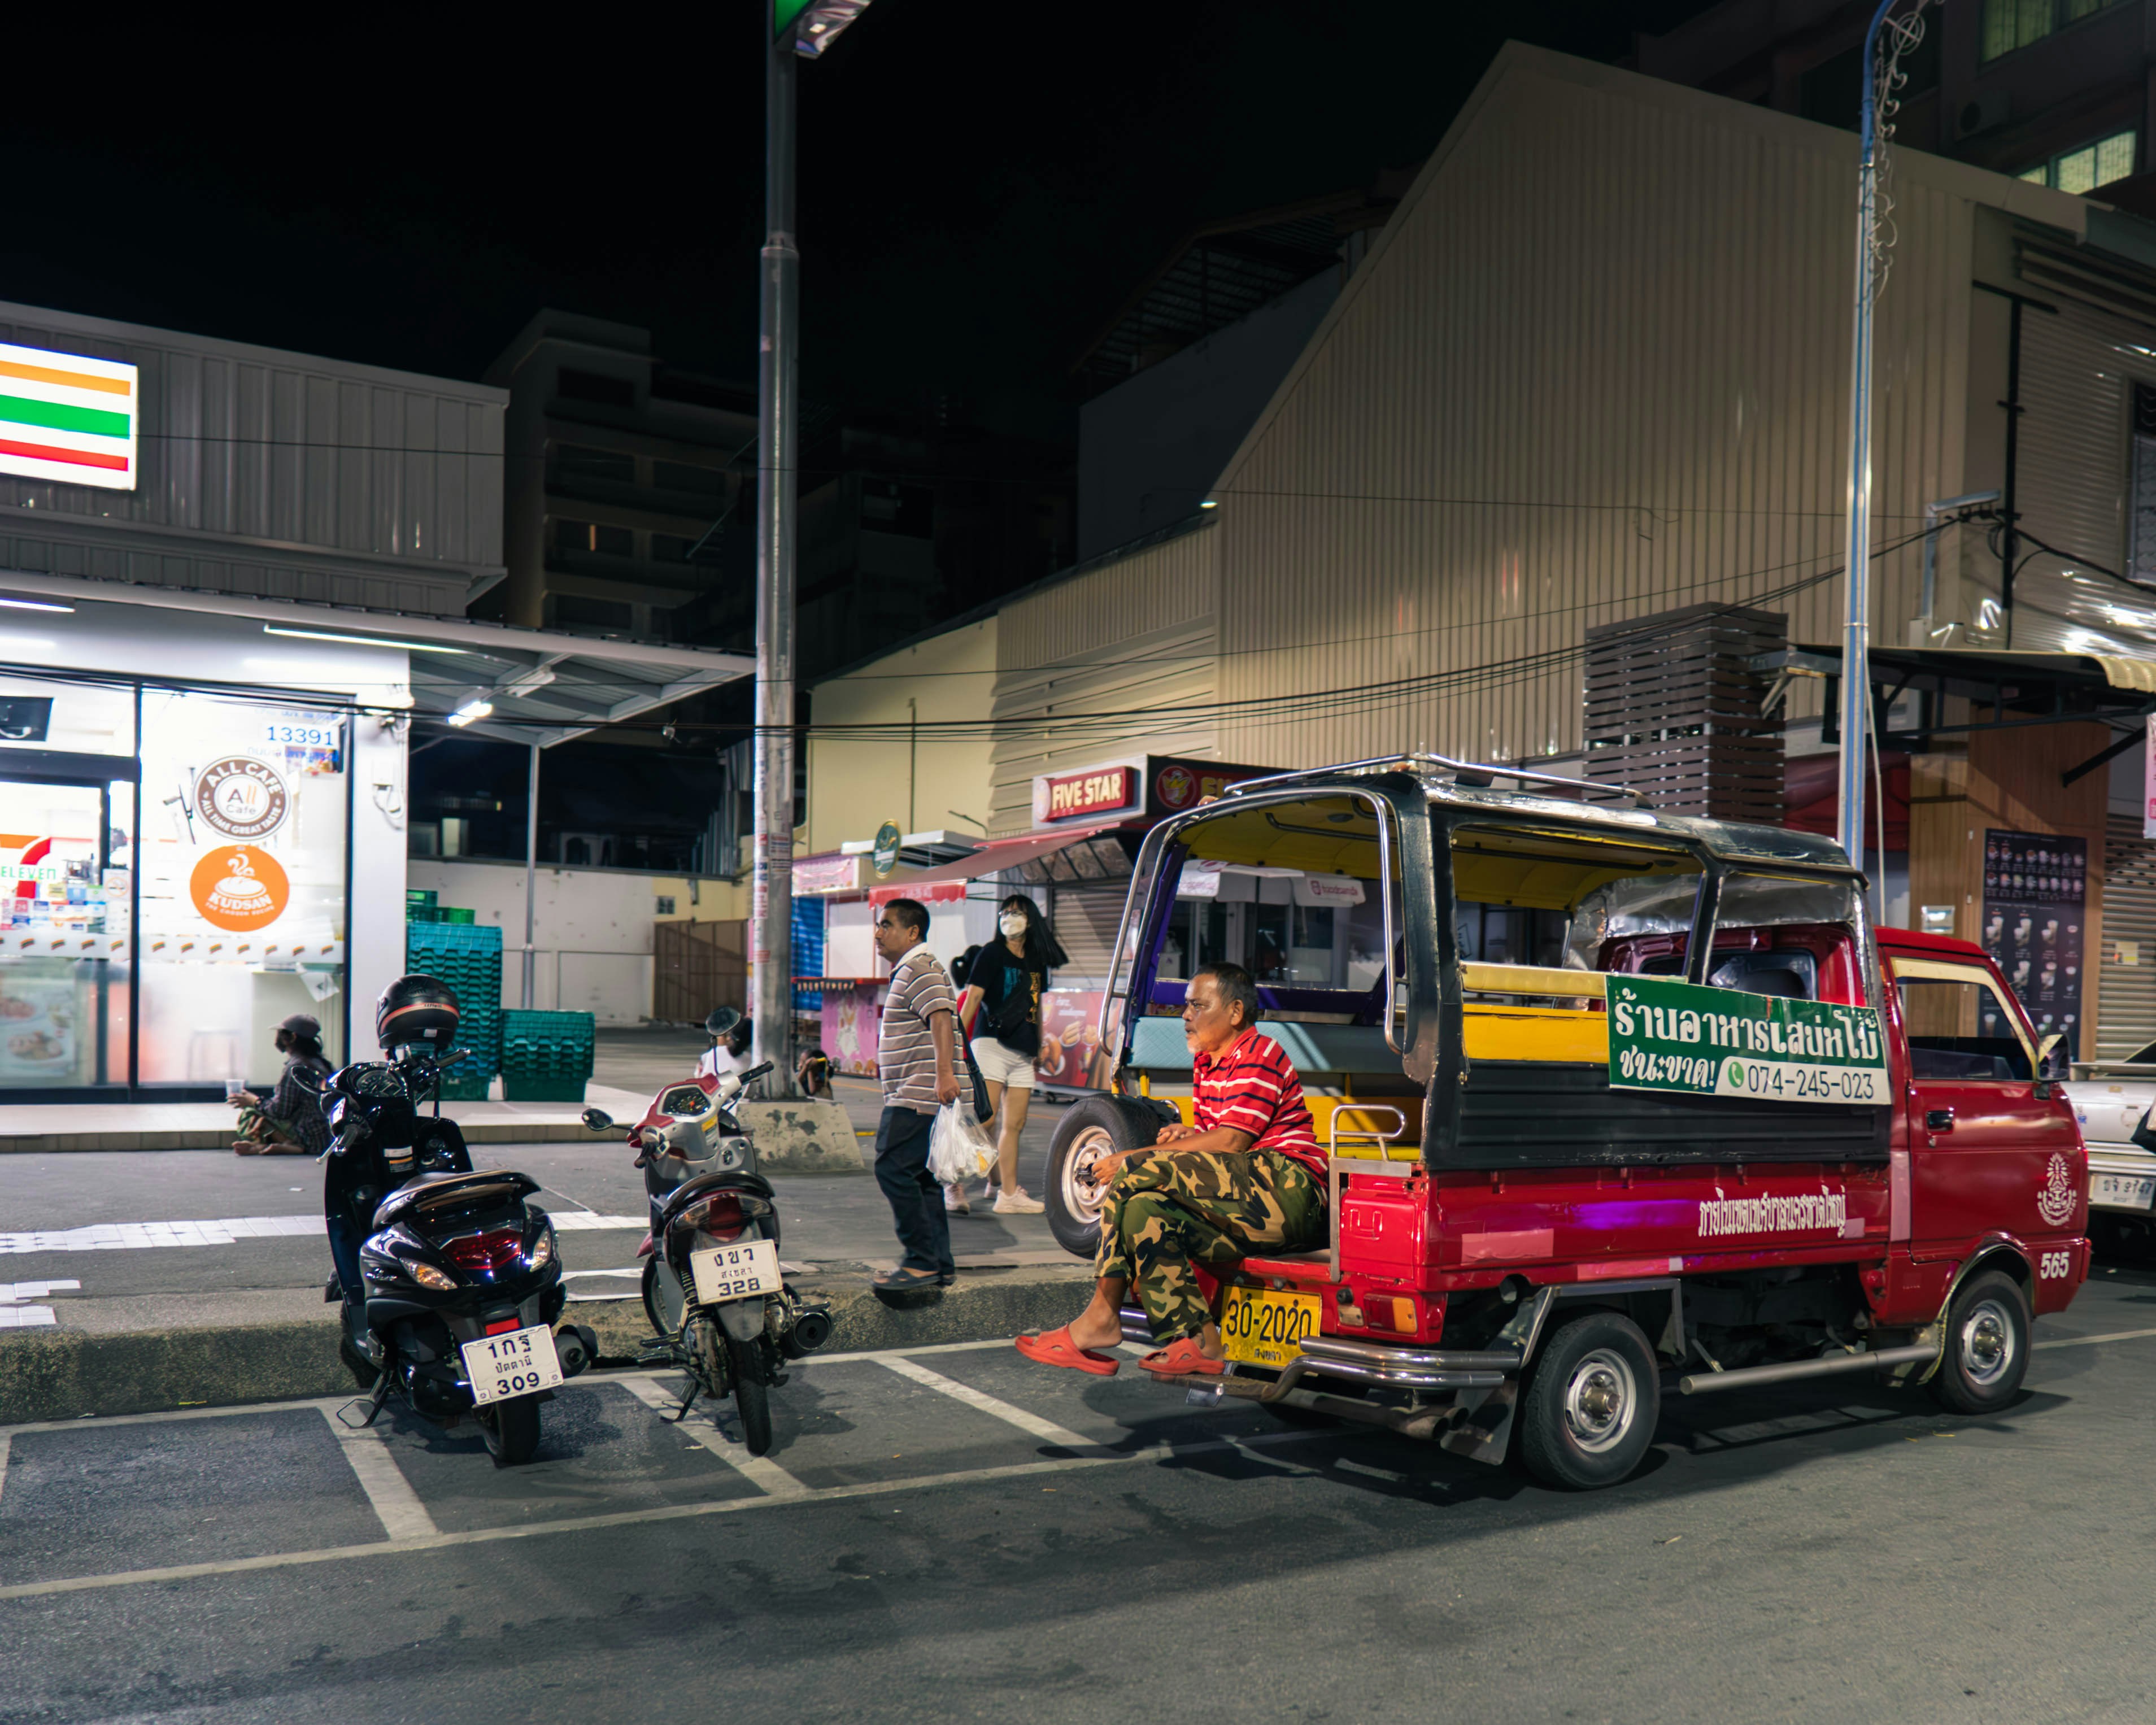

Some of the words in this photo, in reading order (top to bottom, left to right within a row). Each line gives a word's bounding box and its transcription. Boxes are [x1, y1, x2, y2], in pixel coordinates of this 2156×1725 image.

[267, 726, 333, 746] 13391
[206, 761, 242, 788] ALL
[1052, 780, 1083, 811] FIVE
[1084, 772, 1122, 805] STAR
[201, 799, 215, 816] ALL
[209, 813, 232, 831] TIME
[230, 824, 263, 835] GREAT
[260, 806, 282, 829] TASTE
[207, 891, 273, 911] KUDSAN
[1748, 1065, 1874, 1099] 074-245-023
[721, 1267, 753, 1279] สงขลา
[2040, 1251, 2070, 1279] 565
[717, 1277, 761, 1297] 328
[1226, 1299, 1312, 1347] 30-2020
[495, 1355, 533, 1374] ปัตตานี
[496, 1371, 540, 1395] 309
